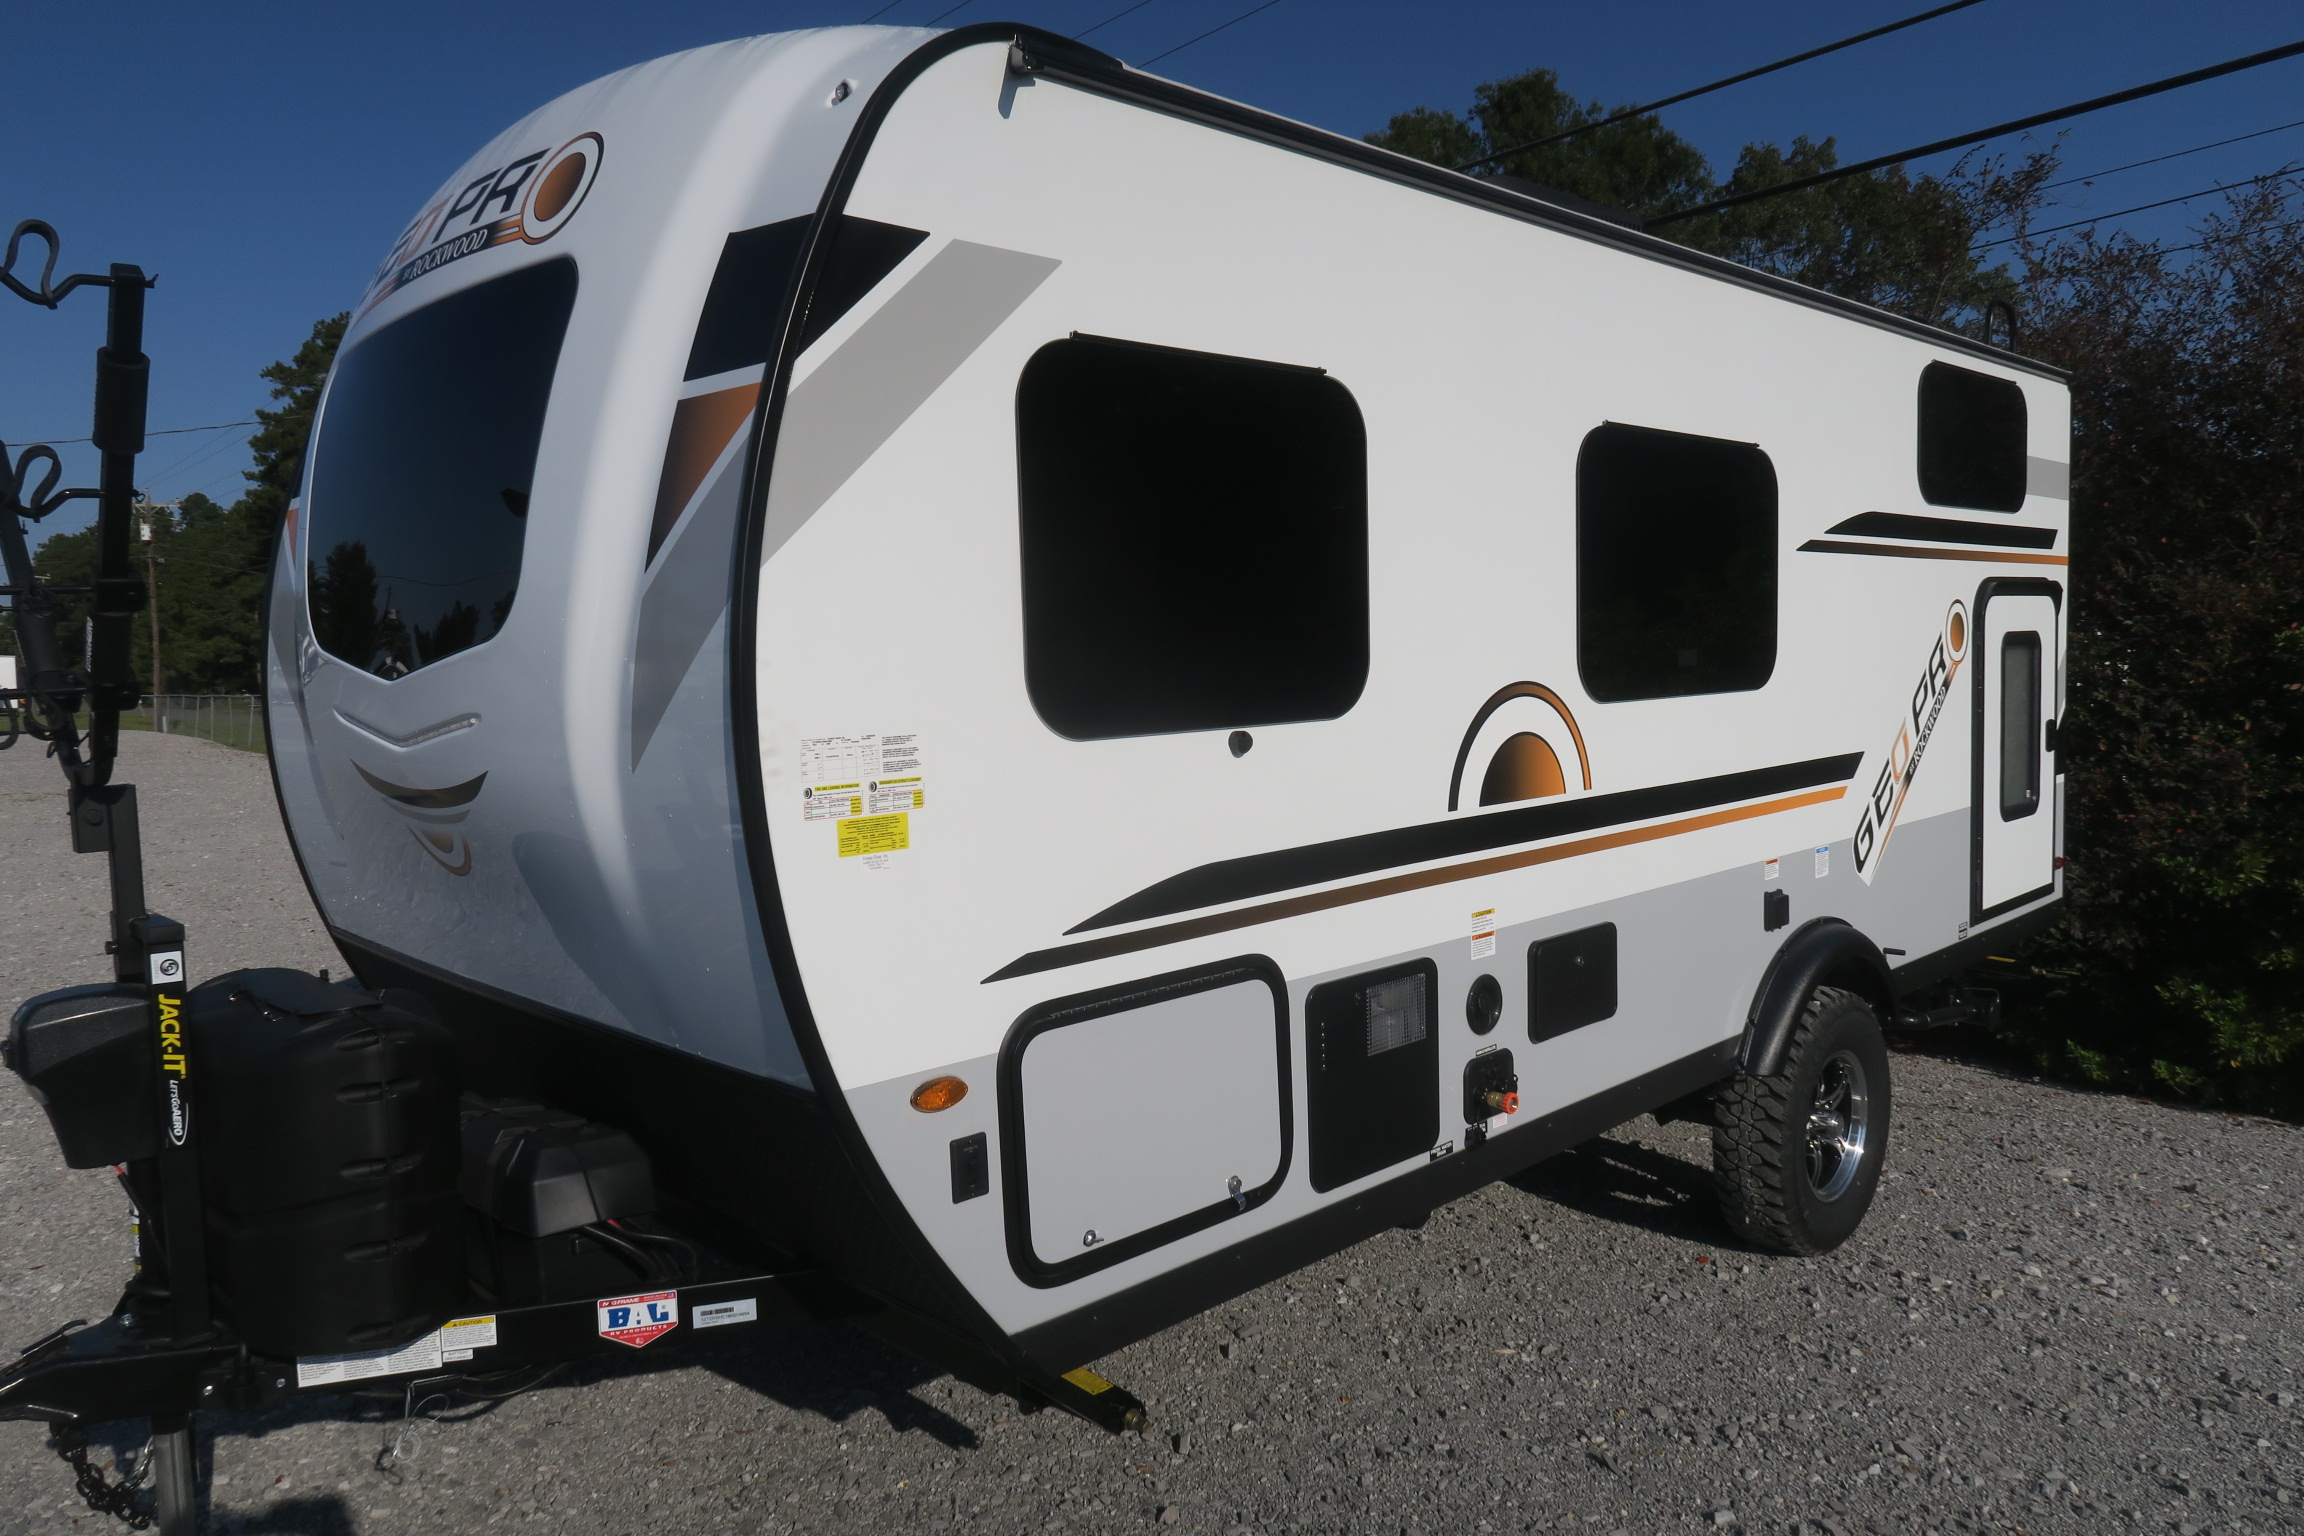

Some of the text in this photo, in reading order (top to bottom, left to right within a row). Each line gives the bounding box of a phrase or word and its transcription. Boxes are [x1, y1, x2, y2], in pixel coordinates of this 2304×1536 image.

[410, 229, 488, 279] ROCKWOOD
[1913, 686, 1946, 767] ROCKWOOD
[158, 994, 186, 1076] JACK-IT
[607, 1303, 669, 1329] BAL
[624, 1324, 667, 1335] PRODUCTS
